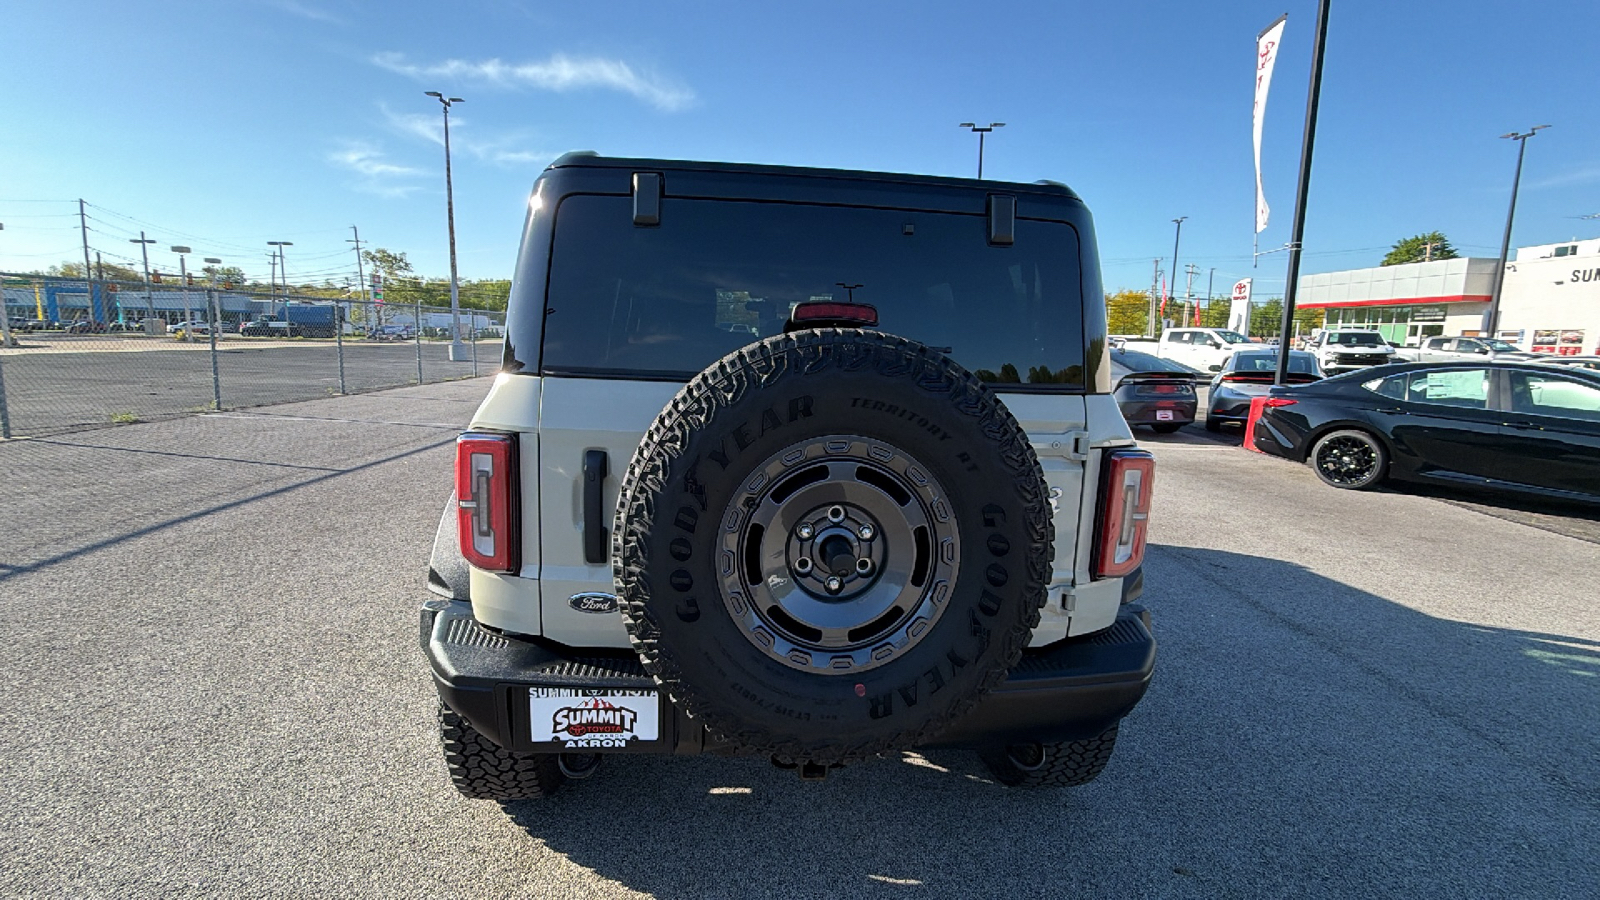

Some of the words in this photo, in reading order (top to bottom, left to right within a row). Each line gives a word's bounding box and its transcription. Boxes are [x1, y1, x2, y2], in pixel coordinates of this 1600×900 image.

[850, 396, 953, 444] TERRITORY
[957, 450, 980, 473] RT
[669, 394, 815, 624] GOODYEAR
[580, 597, 611, 610] Ford
[869, 503, 1012, 720] GOODYEAR
[555, 709, 635, 732] SUMMIT
[587, 725, 622, 733] TOYOTA
[565, 739, 626, 748] AKRON
